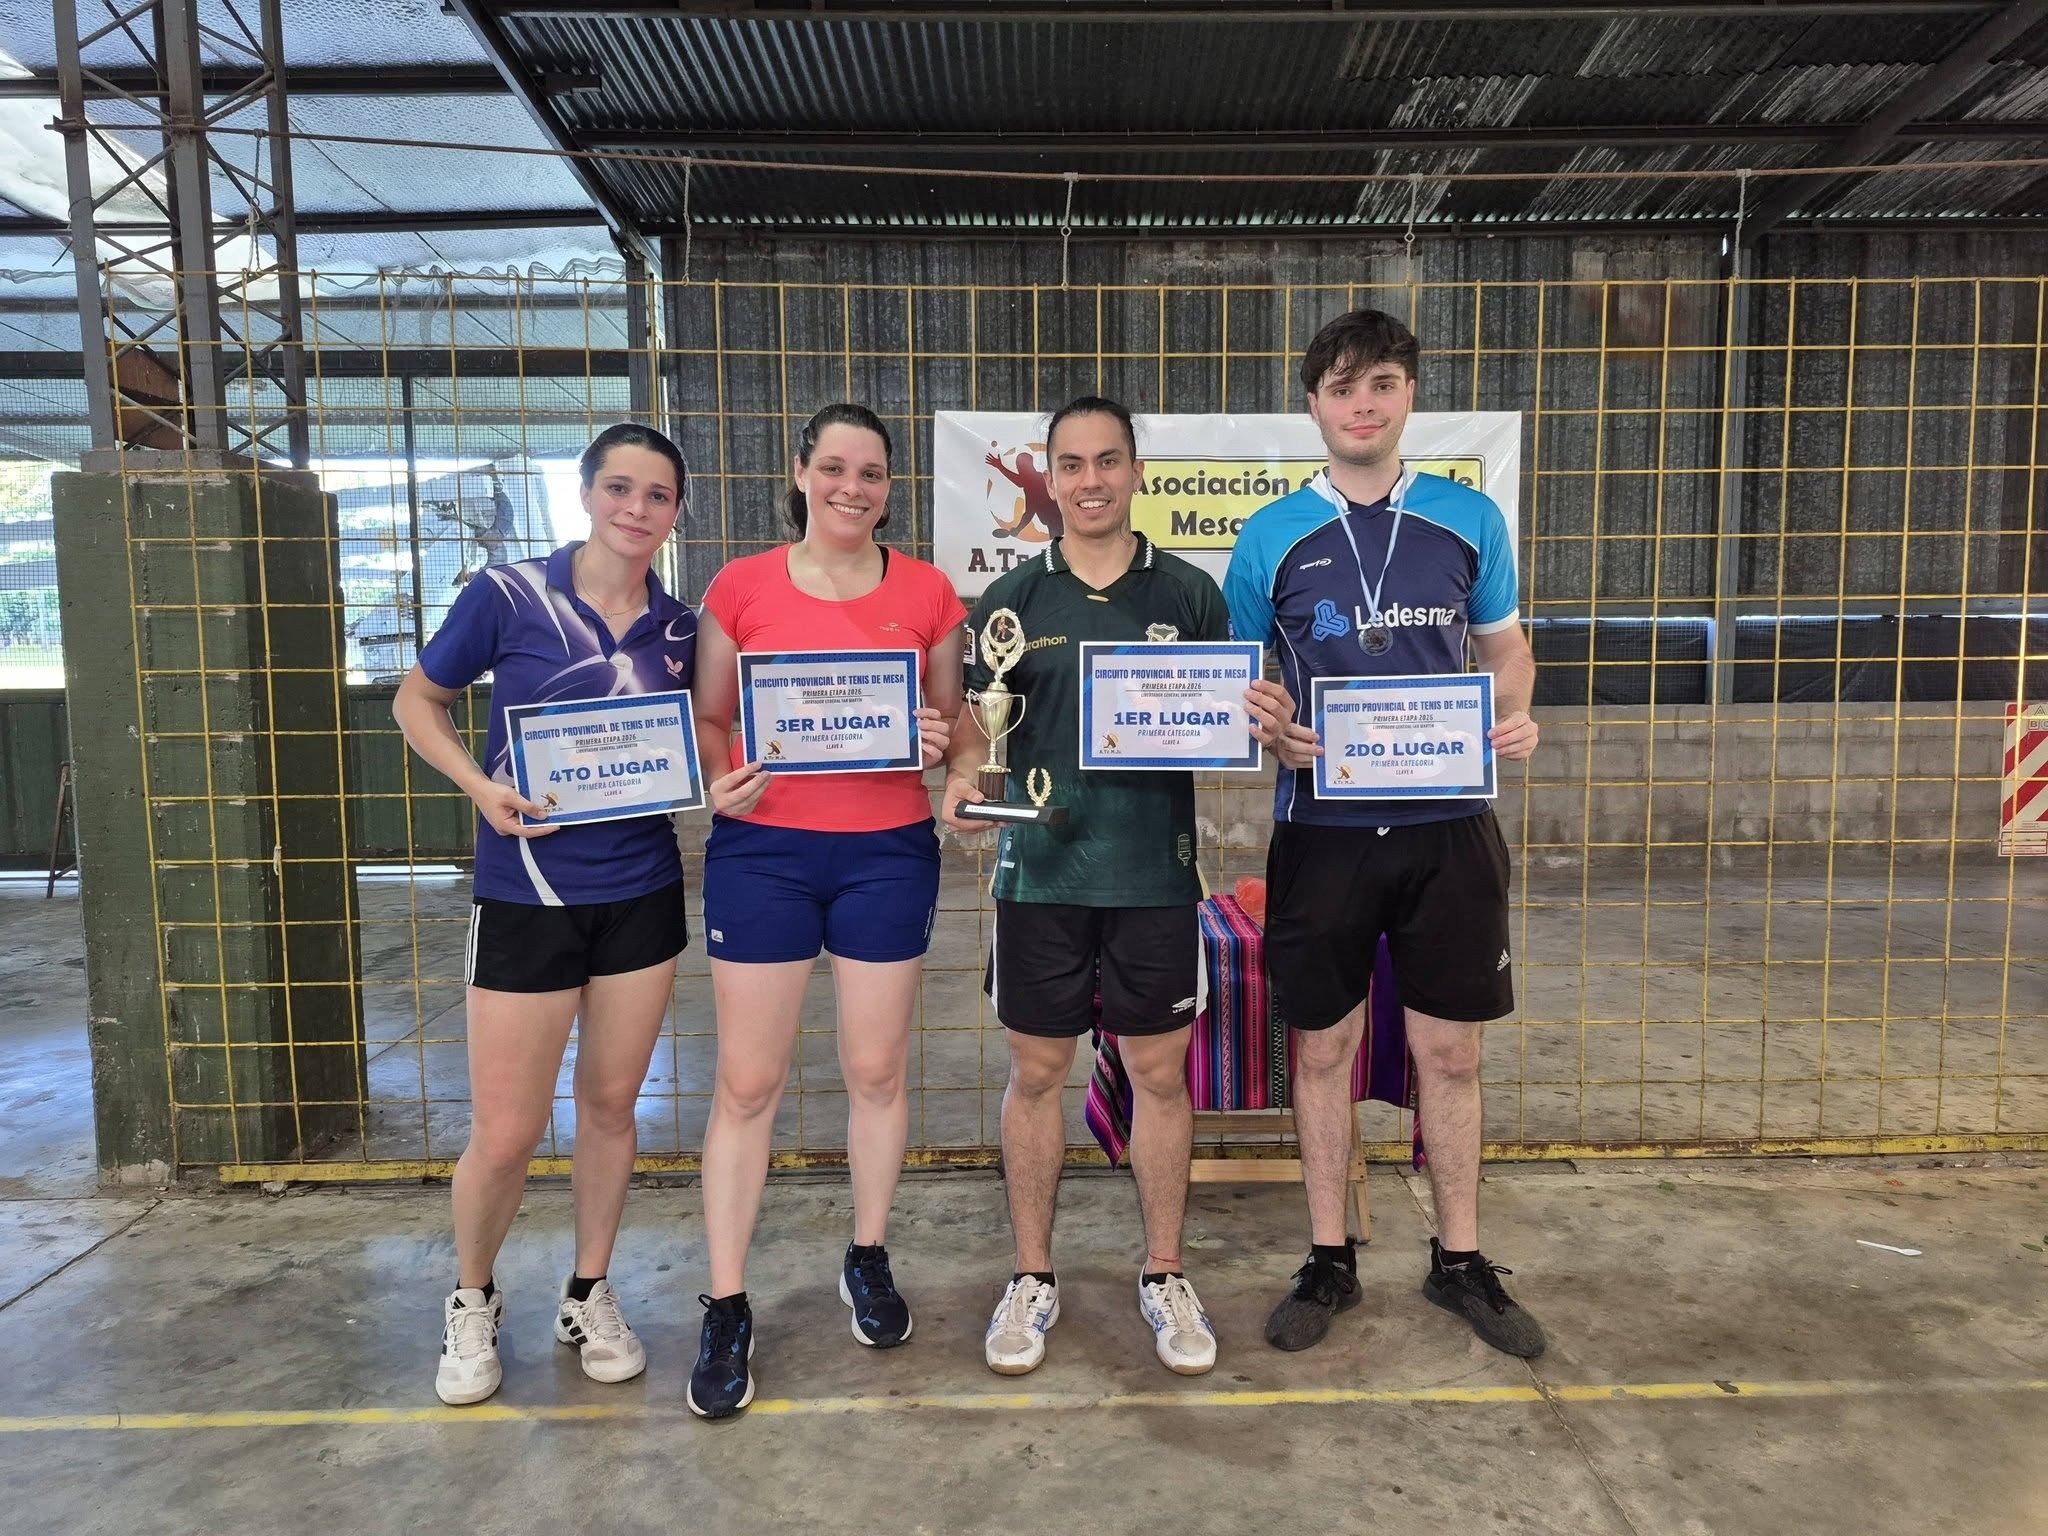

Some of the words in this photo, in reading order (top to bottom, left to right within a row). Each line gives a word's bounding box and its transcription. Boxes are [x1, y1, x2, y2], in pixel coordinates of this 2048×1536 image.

[1095, 669, 1129, 679] CIRCUITO
[1131, 669, 1175, 679] PROVINCIAL
[1177, 669, 1187, 679] DE
[1189, 669, 1210, 679] TENIS
[1212, 669, 1222, 679] DE
[1224, 669, 1247, 679] MESA
[754, 678, 788, 688] CIRCUITO
[791, 676, 834, 687] PROVINCIAL
[837, 675, 847, 685] DE
[848, 675, 870, 685] TENIS
[871, 674, 881, 684] DE
[883, 674, 904, 684] MESA
[1327, 703, 1360, 713] CIRCUITO
[1362, 701, 1405, 712] PROVINCIAL
[1408, 701, 1418, 711] DE
[1420, 700, 1442, 711] TENIS
[1444, 700, 1454, 710] DE
[1456, 700, 1478, 710] MESA
[776, 719, 814, 732] 3ER
[822, 716, 890, 730] LUGAR
[1114, 712, 1152, 725] 1ER
[1159, 712, 1230, 725] LUGAR
[524, 728, 561, 741] CIRCUITO
[562, 724, 608, 737] PROVINCIAL
[610, 723, 620, 732] DE
[621, 720, 643, 731] TENIS
[645, 719, 655, 729] DE
[657, 717, 679, 727] MESA
[576, 737, 601, 746] PRIMERA
[603, 735, 621, 744] ETAPA
[622, 734, 637, 742] 2026
[801, 734, 829, 743] PRIMERA
[830, 733, 863, 741] CATEGORIA
[1345, 743, 1386, 757] 2DO
[1393, 742, 1464, 756] LUGAR
[1370, 760, 1399, 768] PRIMERA
[1400, 759, 1434, 767] CATEGORIA
[549, 767, 591, 783] 4TO
[598, 758, 670, 778] LUGAR
[578, 782, 606, 792] PRIMERA
[608, 778, 642, 788] CATEGORIA
